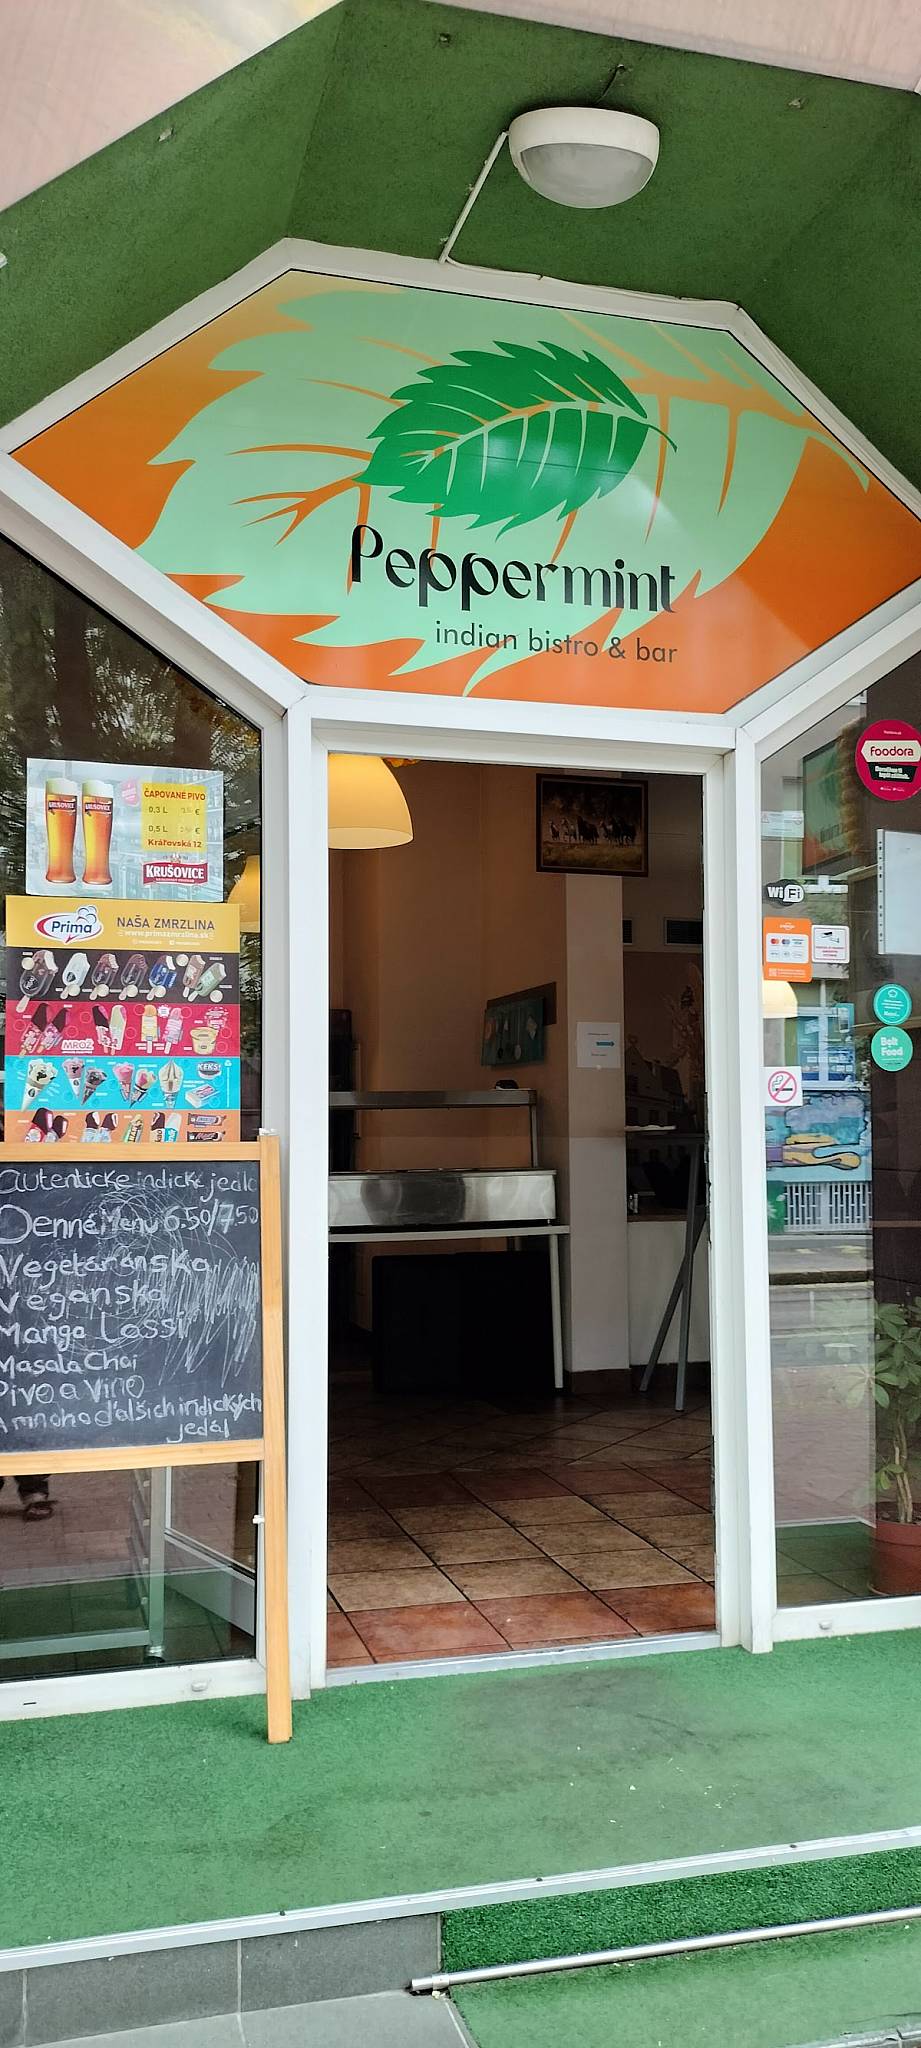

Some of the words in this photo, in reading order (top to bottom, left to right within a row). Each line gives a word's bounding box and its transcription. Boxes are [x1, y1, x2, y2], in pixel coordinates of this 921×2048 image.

[351, 524, 677, 613] Peppermint
[436, 620, 518, 650] indian
[528, 628, 599, 657] bistro
[608, 636, 626, 659] &
[636, 638, 678, 663] bar
[870, 745, 914, 757] foodora
[188, 792, 206, 801] PIVO
[148, 825, 161, 833] 0,5
[193, 840, 202, 848] 12
[146, 864, 205, 879] KRUŠOVICE
[51, 920, 93, 934] Prima
[116, 914, 150, 928] NAŠA
[154, 918, 215, 930] ZMRZLINA
[880, 1036, 898, 1046] Bolt
[881, 1047, 904, 1056] Food
[0, 1354, 84, 1379] Masala
[84, 1351, 138, 1371] Chai
